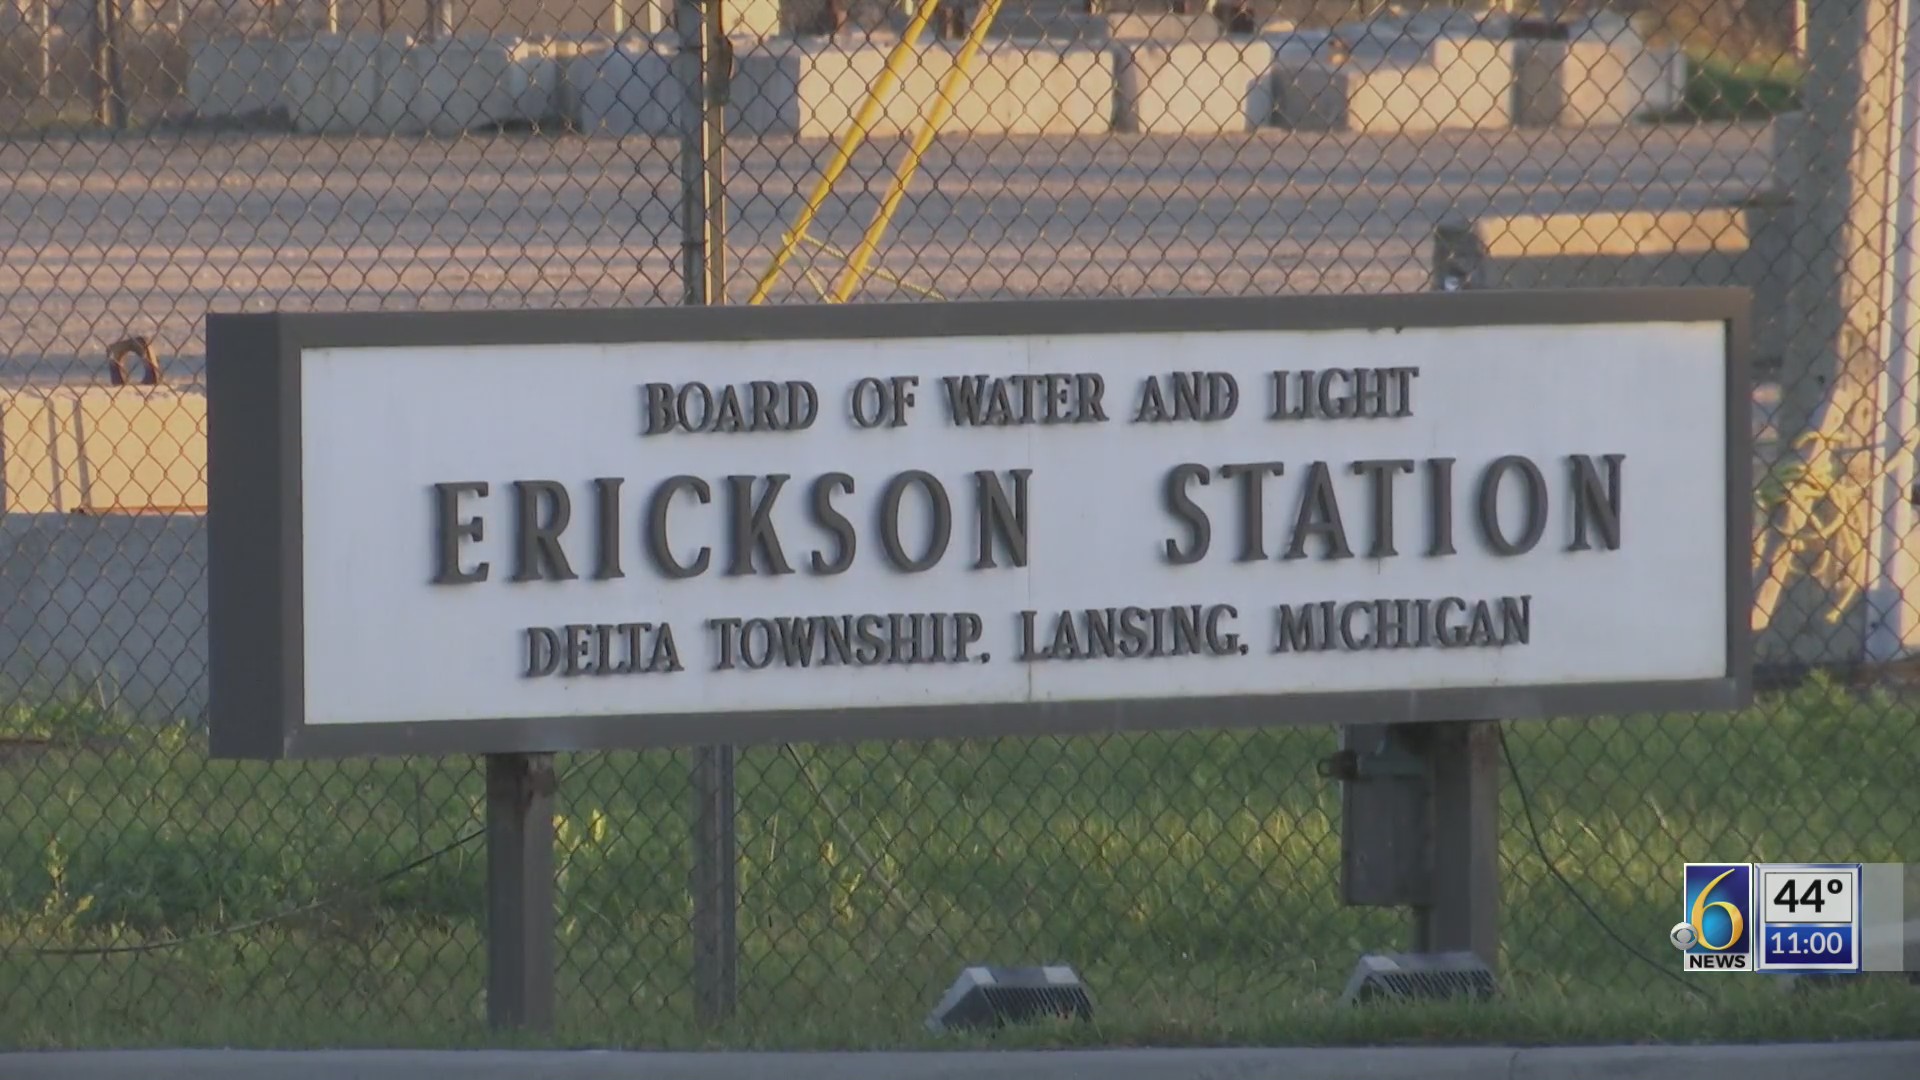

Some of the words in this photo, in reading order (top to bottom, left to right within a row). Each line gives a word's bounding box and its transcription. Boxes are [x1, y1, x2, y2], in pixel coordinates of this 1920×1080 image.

[643, 382, 817, 434] BOARD
[852, 376, 918, 428] OF
[944, 373, 1109, 426] WATER
[1133, 371, 1239, 424] AND
[1268, 366, 1420, 420] LIGHT
[433, 468, 1032, 584] ERICKSON
[1163, 454, 1626, 566] STATION
[524, 623, 684, 678] DELTA
[1275, 594, 1533, 653] MICHIGAN
